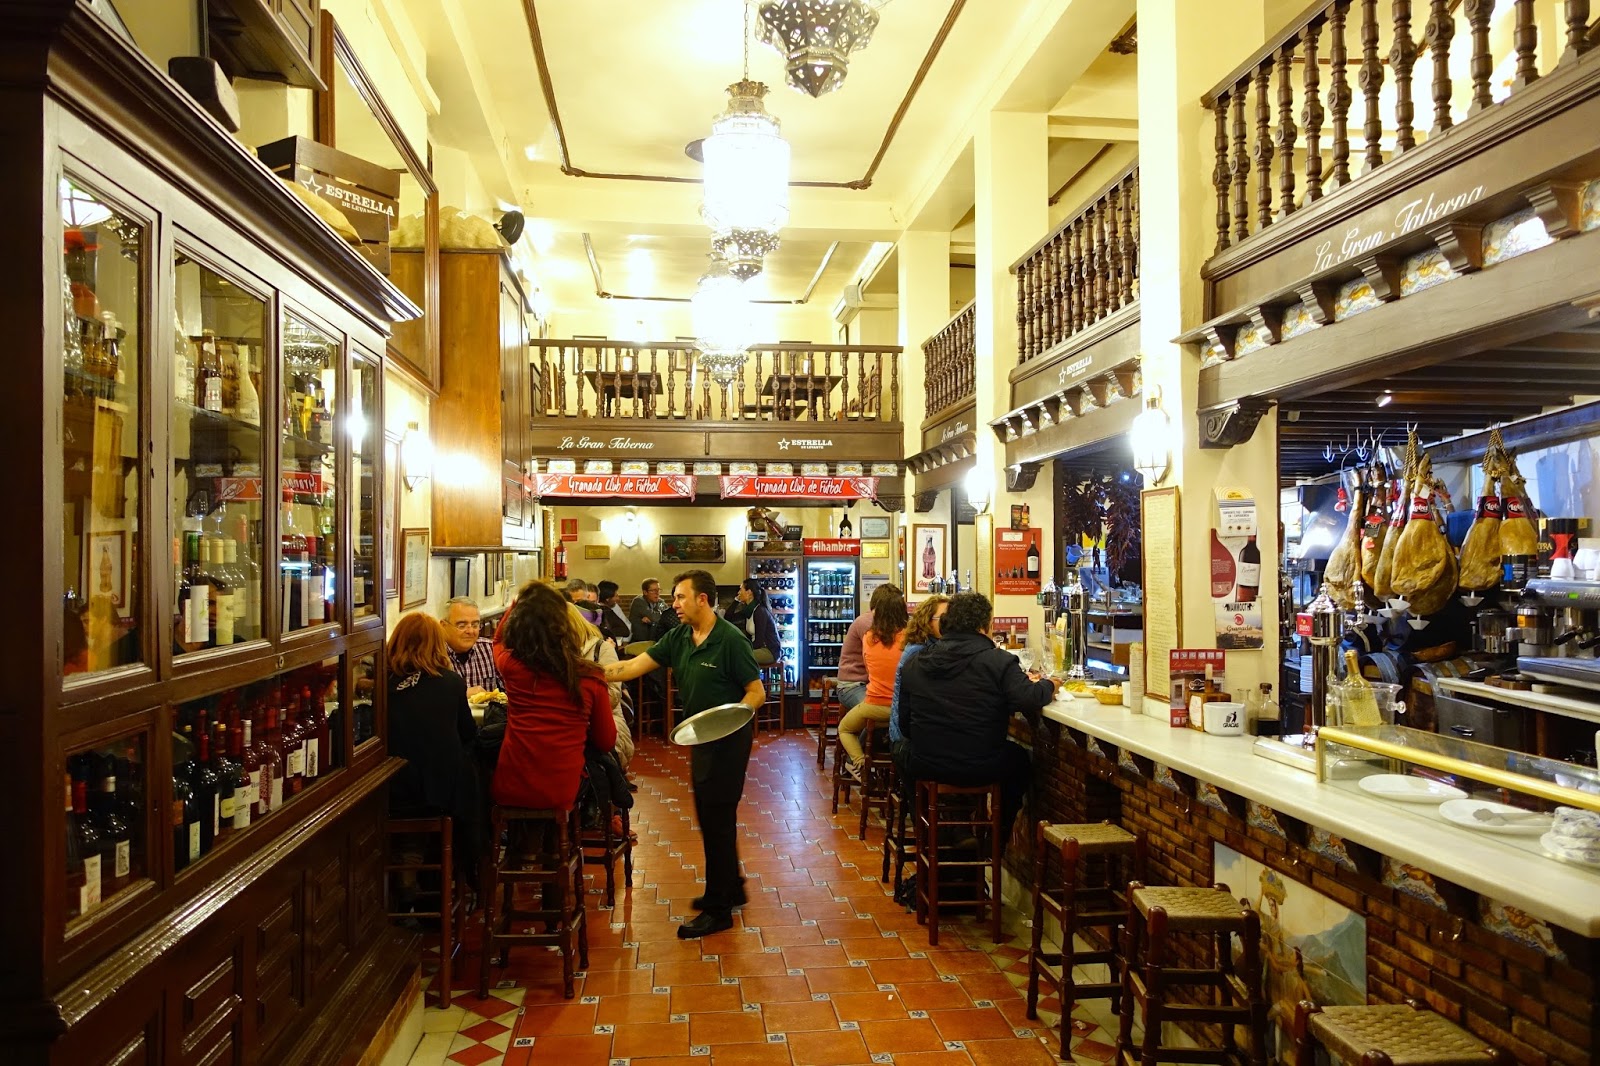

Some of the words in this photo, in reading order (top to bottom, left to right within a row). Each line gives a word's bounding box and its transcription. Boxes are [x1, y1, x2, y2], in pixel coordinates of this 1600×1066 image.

[325, 184, 395, 217] ESTRELLA
[342, 201, 351, 209] DE
[1310, 240, 1334, 276] La
[1337, 227, 1386, 262] Gran
[1391, 185, 1488, 239] Taberna
[557, 436, 574, 450] La
[576, 435, 605, 449] Gran
[608, 437, 655, 449] Taberna
[568, 476, 603, 495] Granada
[605, 476, 621, 493] Club
[623, 478, 634, 492] de
[754, 477, 787, 497] Granada
[789, 476, 806, 494] Club
[807, 479, 818, 492] de
[812, 541, 852, 552] Alhambra
